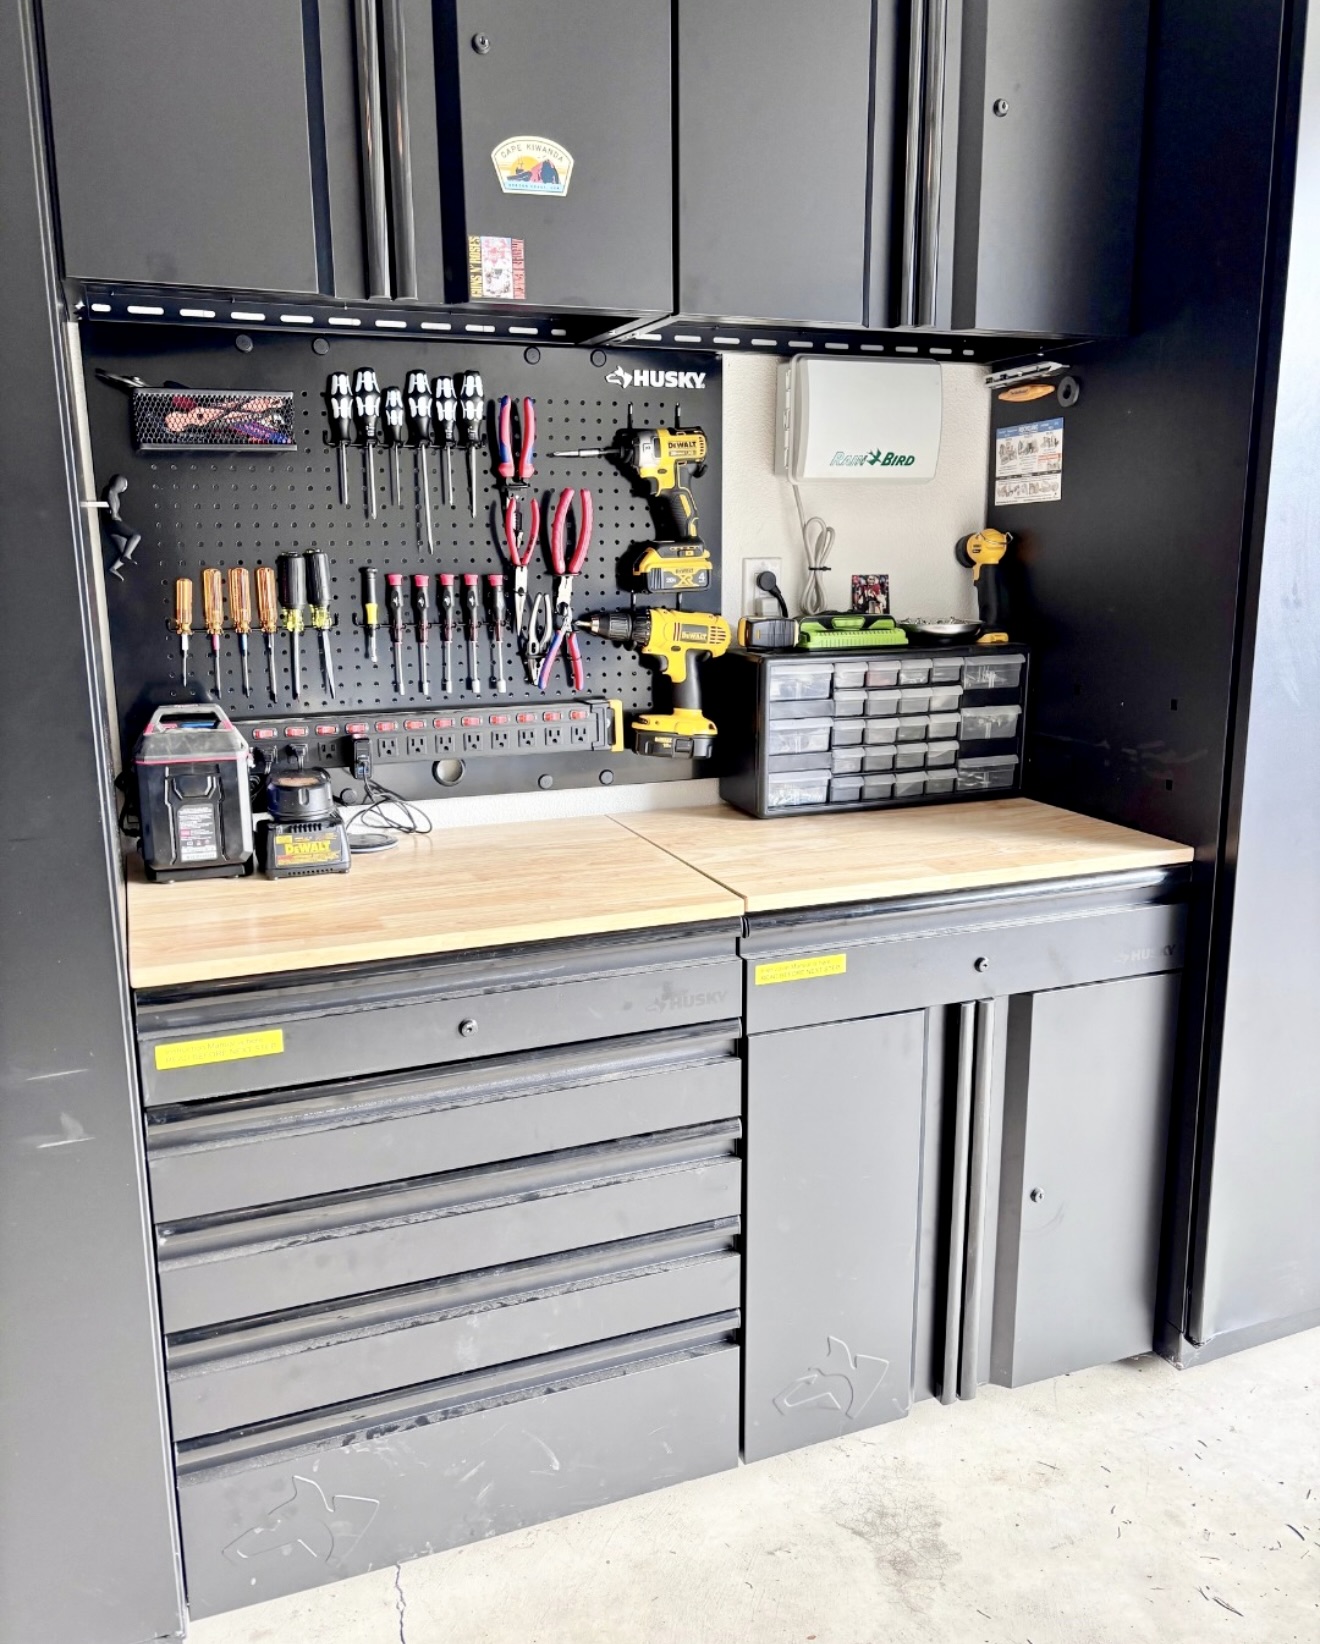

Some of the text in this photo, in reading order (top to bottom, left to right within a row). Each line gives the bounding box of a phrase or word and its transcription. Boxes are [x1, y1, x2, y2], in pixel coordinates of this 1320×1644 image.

[500, 144, 564, 163] CAPE KIWANDA
[468, 236, 482, 263] ROSES
[470, 275, 483, 298] GUNS
[633, 369, 706, 389] HUSKY
[829, 450, 916, 466] RAIN BIRD
[669, 991, 729, 1010] HUSKY
